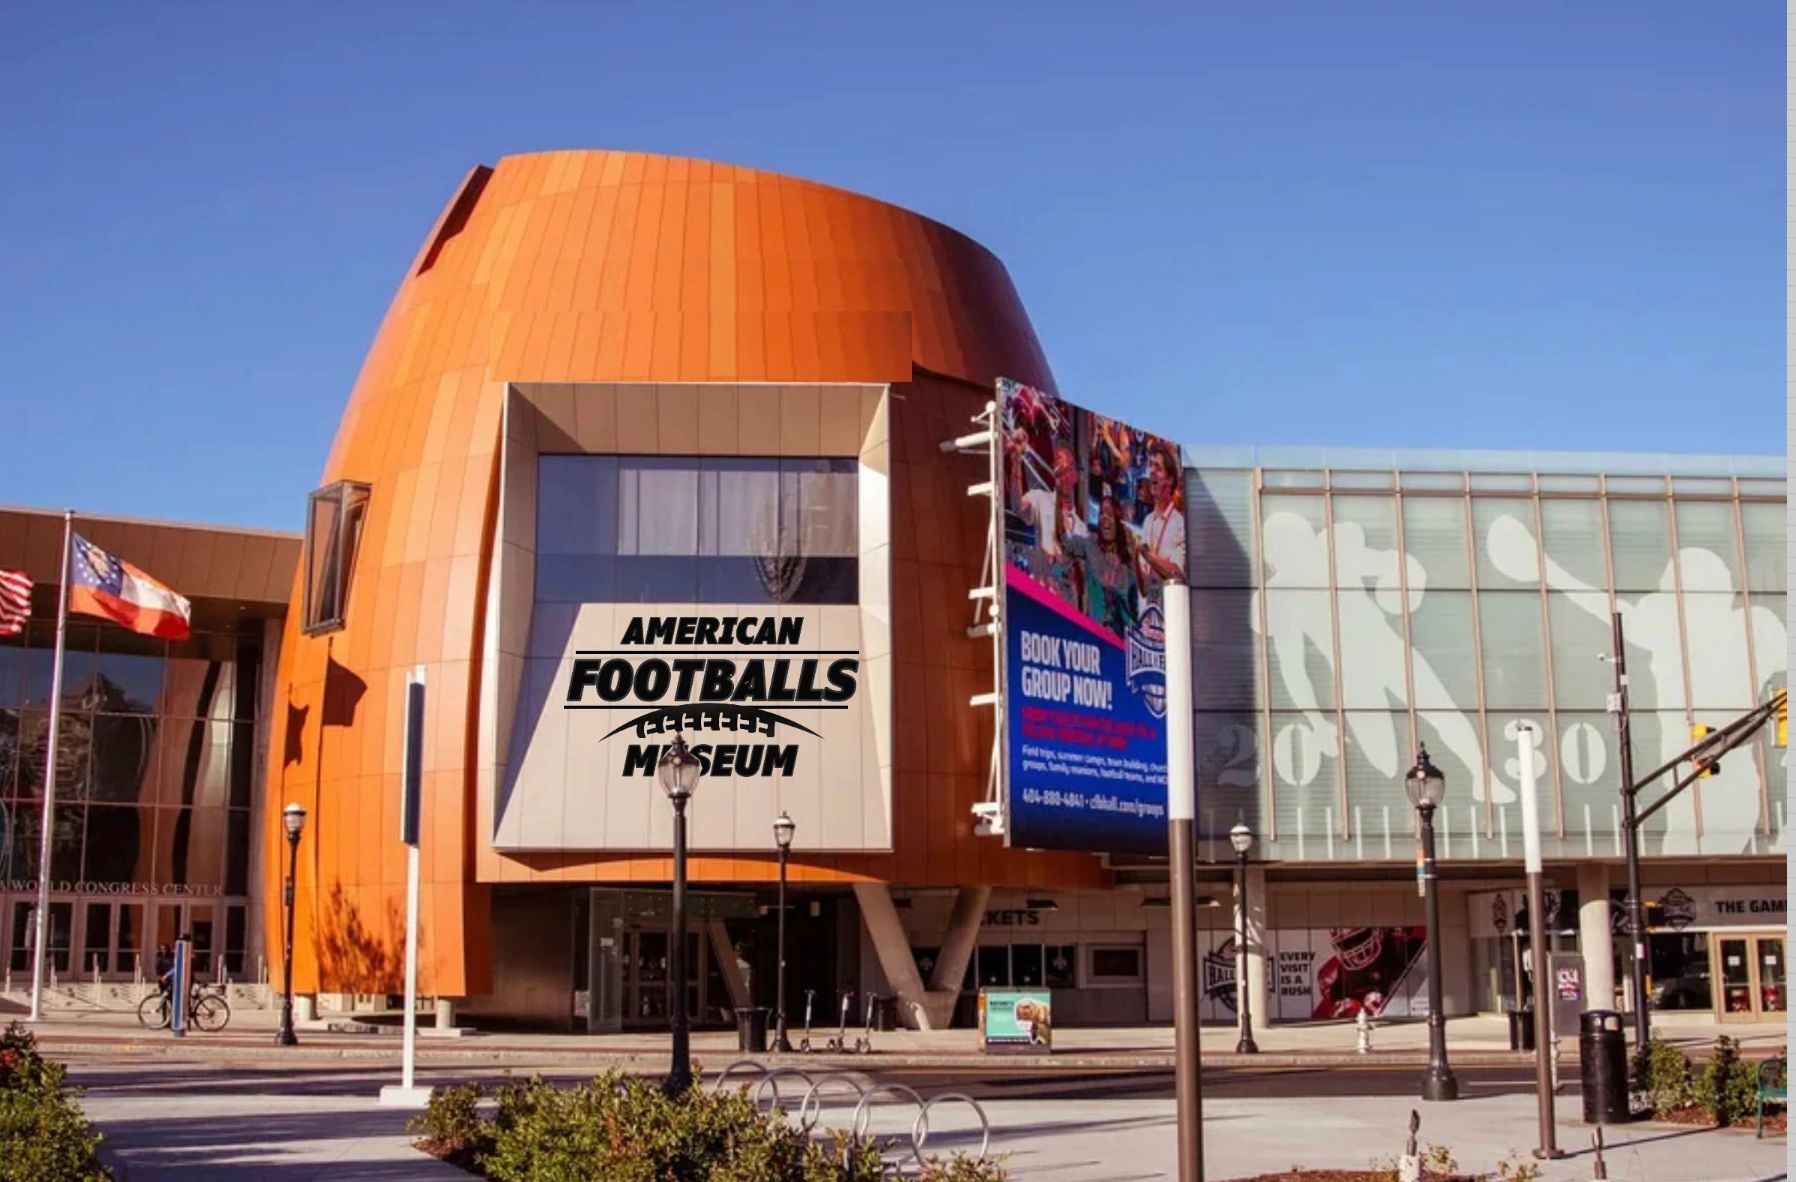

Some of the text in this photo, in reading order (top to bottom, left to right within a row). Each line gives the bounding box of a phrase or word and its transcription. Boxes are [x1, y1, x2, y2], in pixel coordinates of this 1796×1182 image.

[621, 617, 804, 645] AMERICAN
[1021, 630, 1061, 668] BOOK
[1063, 639, 1101, 675] YOUR
[567, 658, 860, 702] FOOTBALLS
[1022, 666, 1113, 710] GROUP NOW!
[622, 744, 799, 778] MSEUM
[12, 880, 71, 892] WOLD
[75, 880, 157, 895] CONGRESS
[163, 884, 225, 897] CENTER
[1715, 900, 1787, 914] THE GAM
[1280, 952, 1316, 961] EVERY
[1280, 964, 1310, 973] VISIT
[1280, 976, 1303, 984] IS A
[1281, 987, 1312, 996] RUSH
